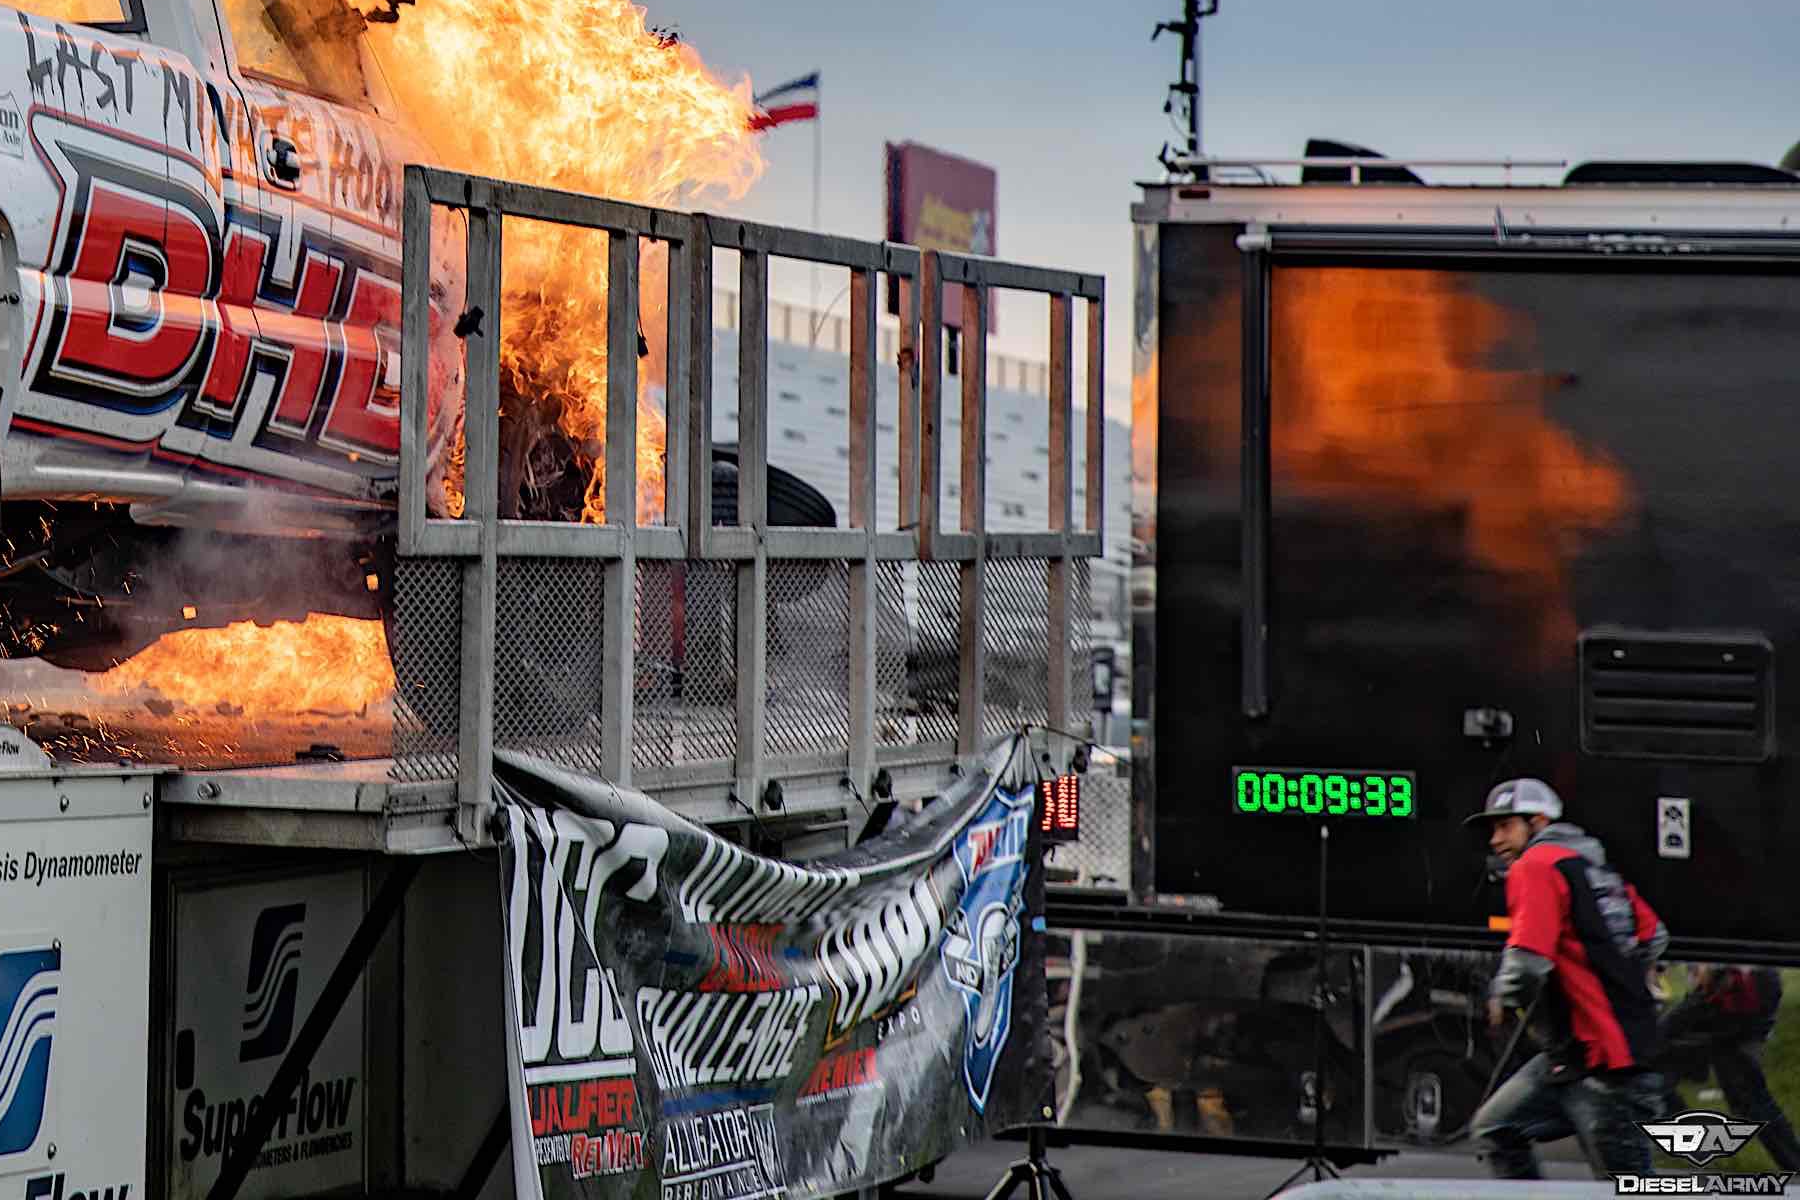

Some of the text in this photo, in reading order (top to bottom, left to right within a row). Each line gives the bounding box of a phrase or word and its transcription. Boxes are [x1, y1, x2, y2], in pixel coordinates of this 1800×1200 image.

[16, 9, 143, 120] LAST
[1237, 772, 1412, 816] 00:09:33
[24, 848, 142, 887] Dynamometer
[637, 985, 822, 1090] CHALLENGE
[663, 1108, 754, 1175] ALLIGATOR
